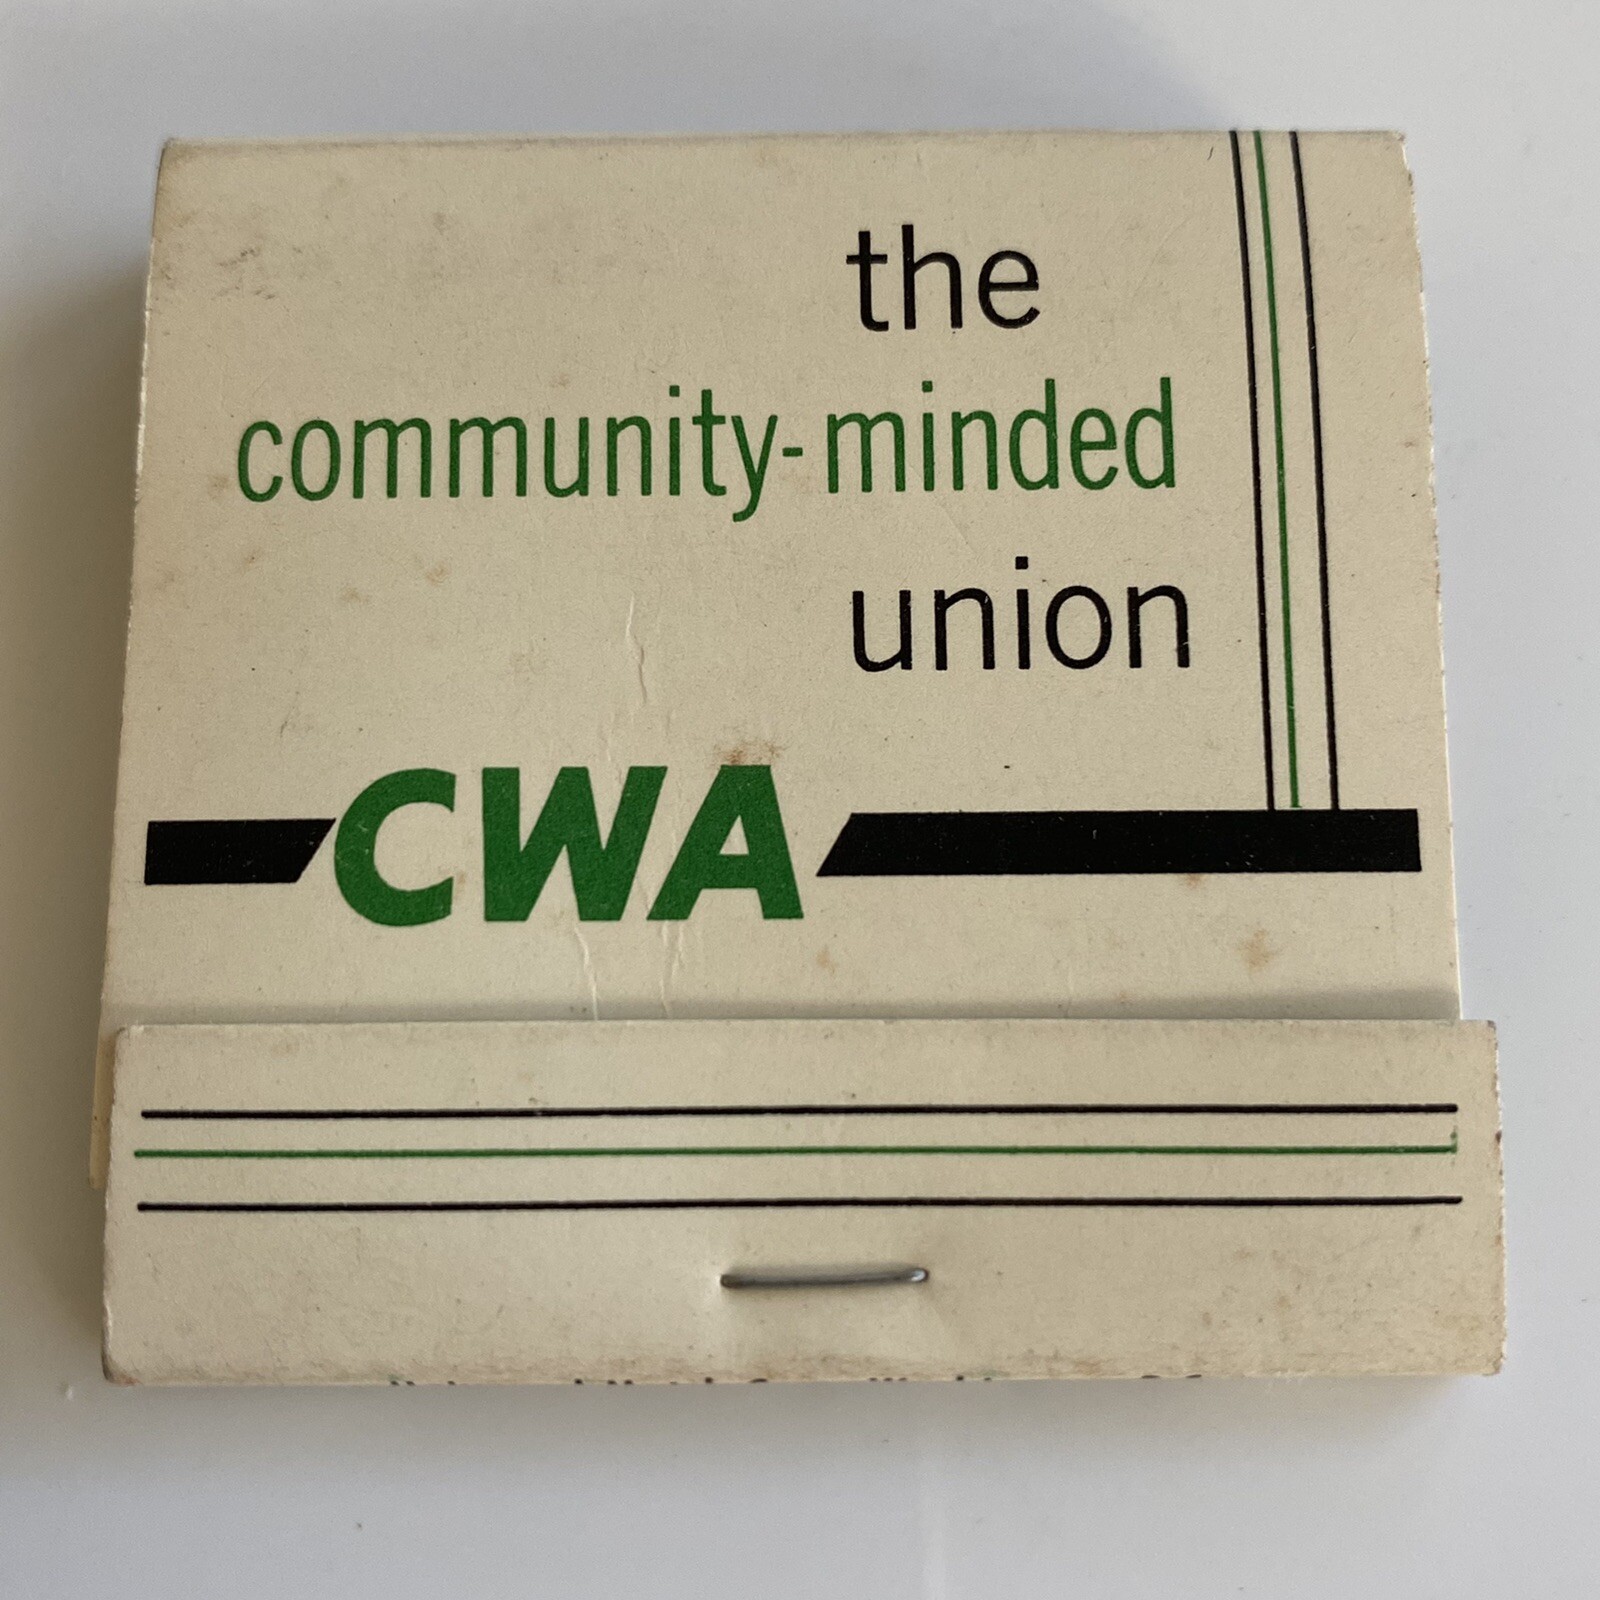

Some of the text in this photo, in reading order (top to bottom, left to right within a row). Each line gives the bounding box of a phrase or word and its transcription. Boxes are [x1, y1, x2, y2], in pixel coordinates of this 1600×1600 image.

[846, 224, 1041, 331] the
[852, 555, 1190, 673] union
[334, 764, 804, 928] CWA
